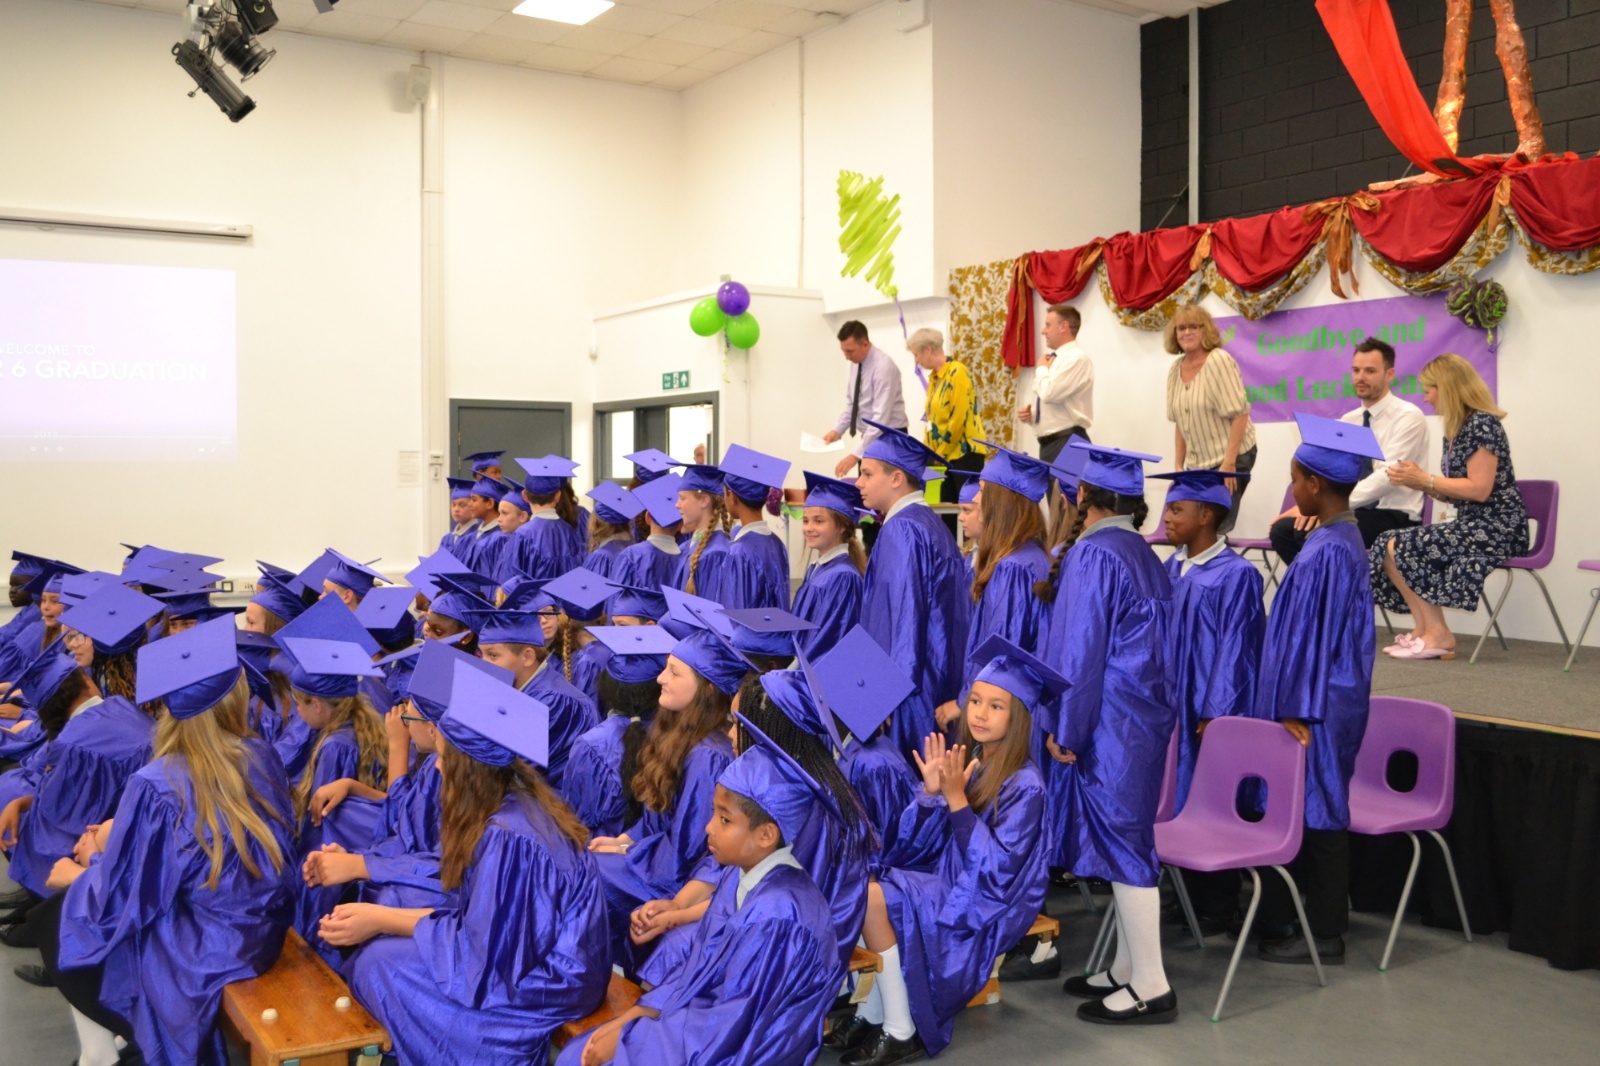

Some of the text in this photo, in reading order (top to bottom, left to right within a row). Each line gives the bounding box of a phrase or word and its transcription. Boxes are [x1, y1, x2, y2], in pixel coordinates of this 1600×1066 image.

[1256, 315, 1426, 356] Goodbye and
[75, 344, 96, 357] TO
[12, 359, 27, 378] 6
[35, 359, 207, 382] GRADUATION
[1245, 376, 1288, 404] ood
